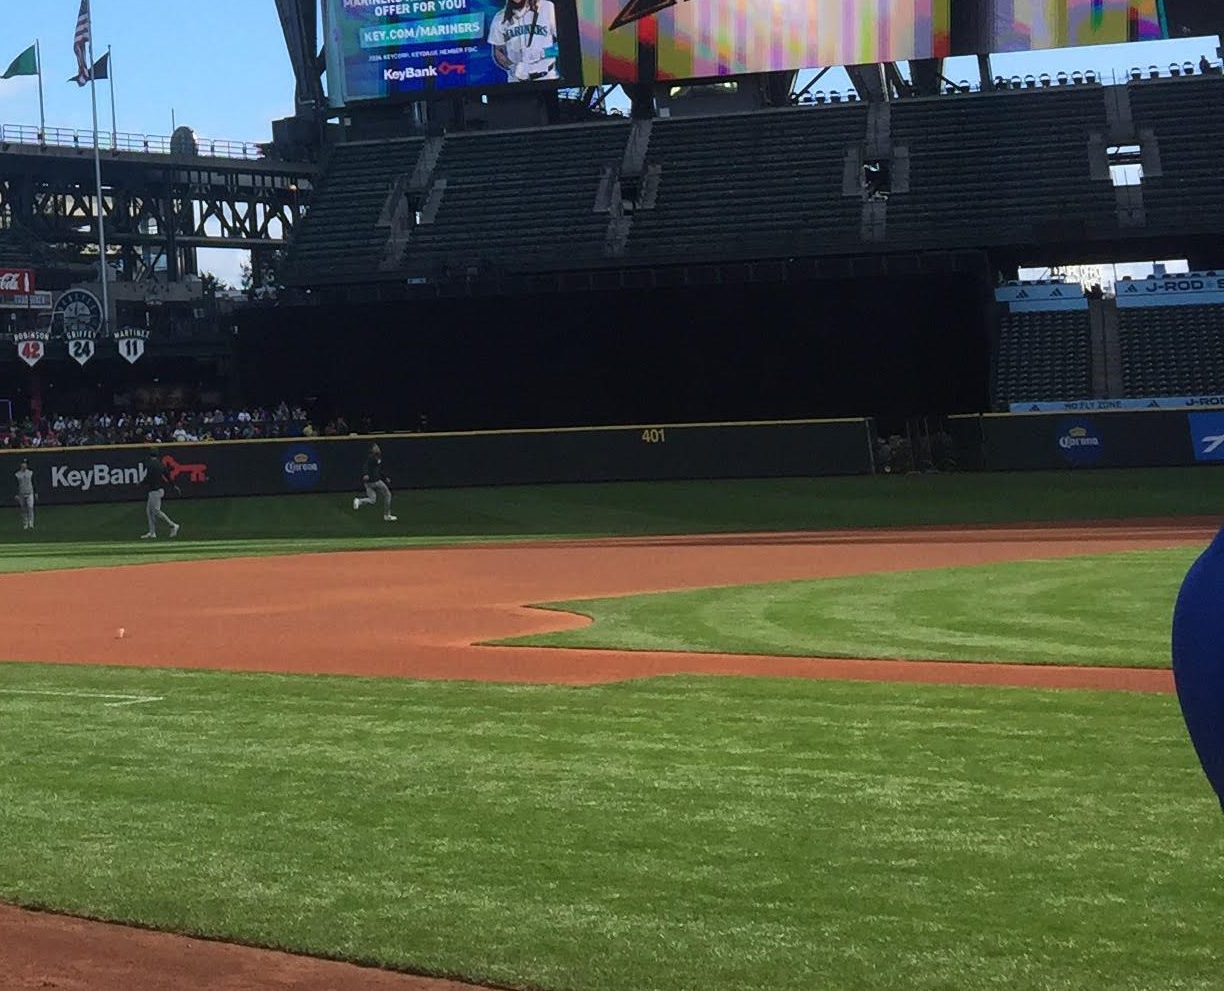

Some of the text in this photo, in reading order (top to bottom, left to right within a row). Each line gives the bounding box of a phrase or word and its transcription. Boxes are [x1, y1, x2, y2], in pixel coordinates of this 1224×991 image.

[374, 3, 410, 17] OFFER
[413, 0, 437, 14] FOR
[364, 21, 481, 43] KEY.COM/MARINERS
[383, 66, 438, 81] KeyBank
[1146, 280, 1204, 293] J-ROD
[14, 331, 51, 341] ROBINSON
[22, 342, 41, 358] 42
[73, 342, 91, 358] 24
[126, 340, 138, 357] 11
[642, 429, 665, 443] 401
[1059, 436, 1099, 448] Corona
[284, 461, 318, 474] Corona
